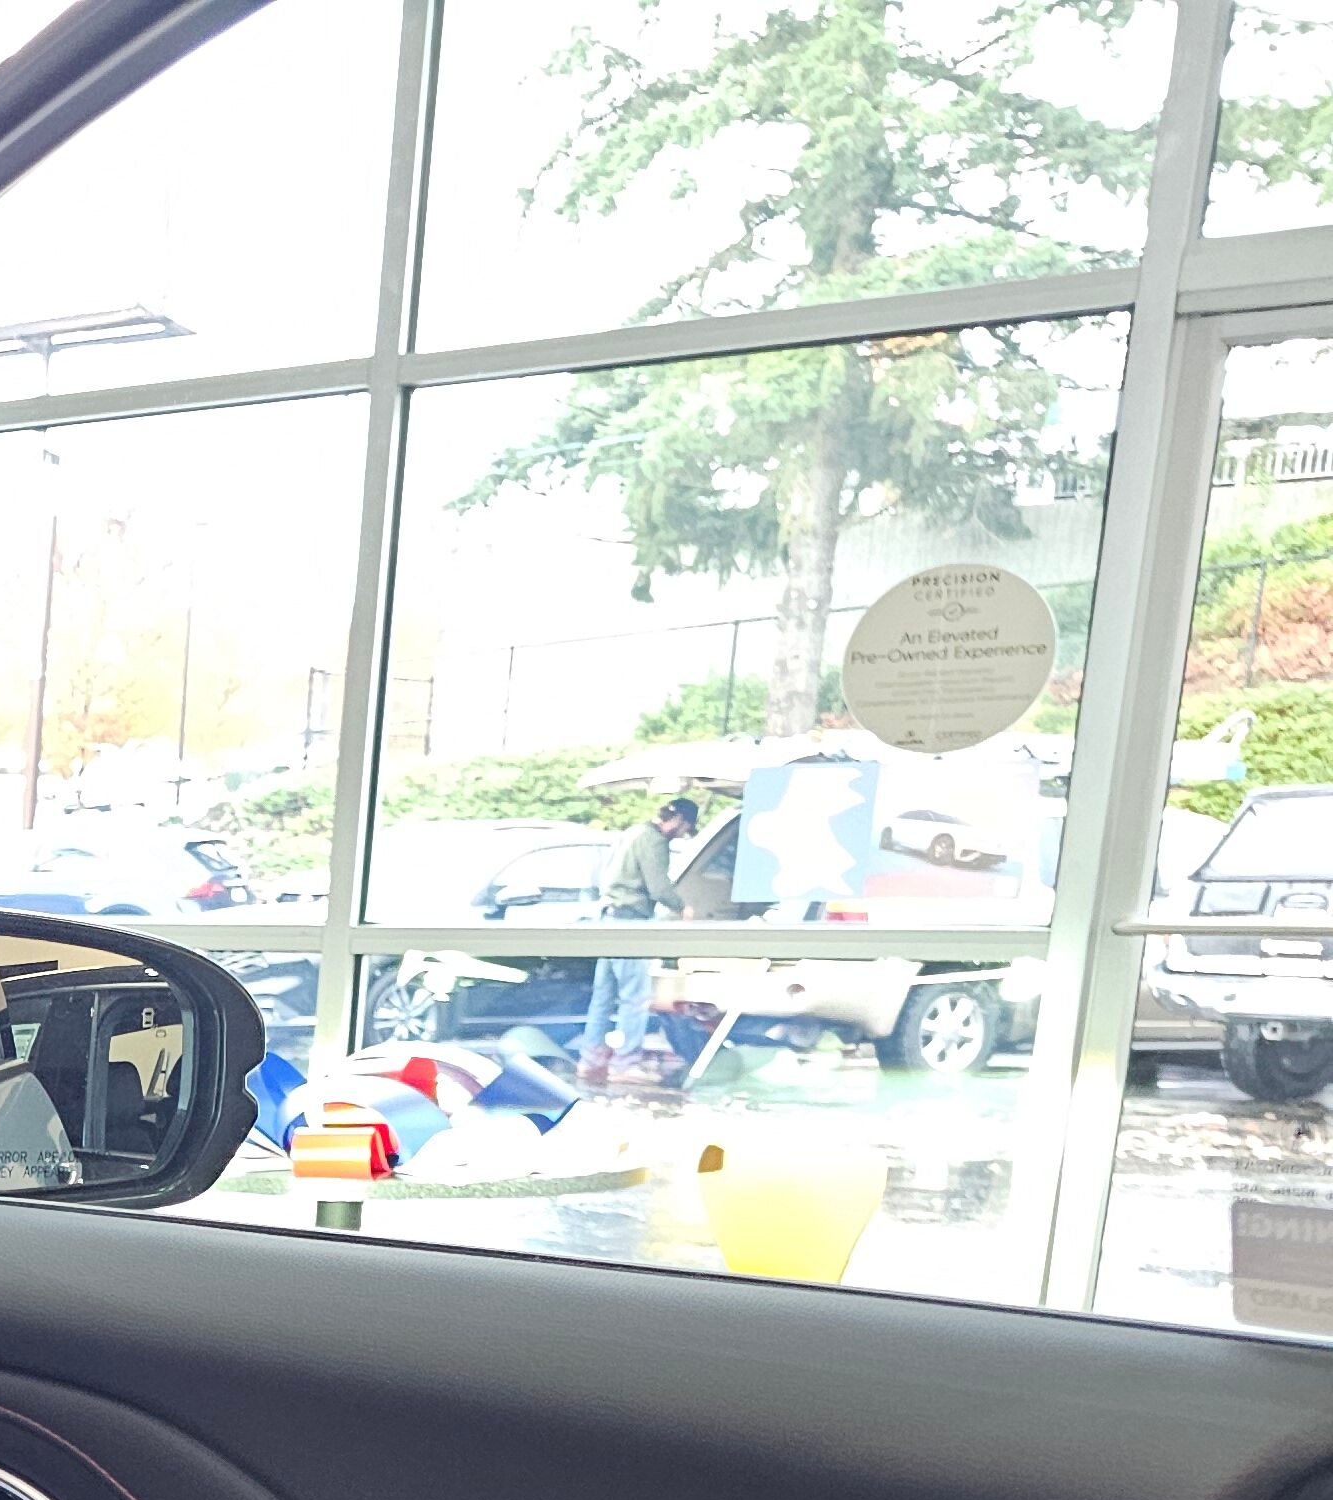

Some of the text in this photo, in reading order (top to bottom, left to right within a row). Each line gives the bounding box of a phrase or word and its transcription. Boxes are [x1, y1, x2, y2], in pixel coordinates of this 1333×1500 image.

[911, 572, 1001, 587] PRECISION
[900, 626, 1000, 645] An Elevated
[851, 643, 1048, 666] Pre-Owned Experience
